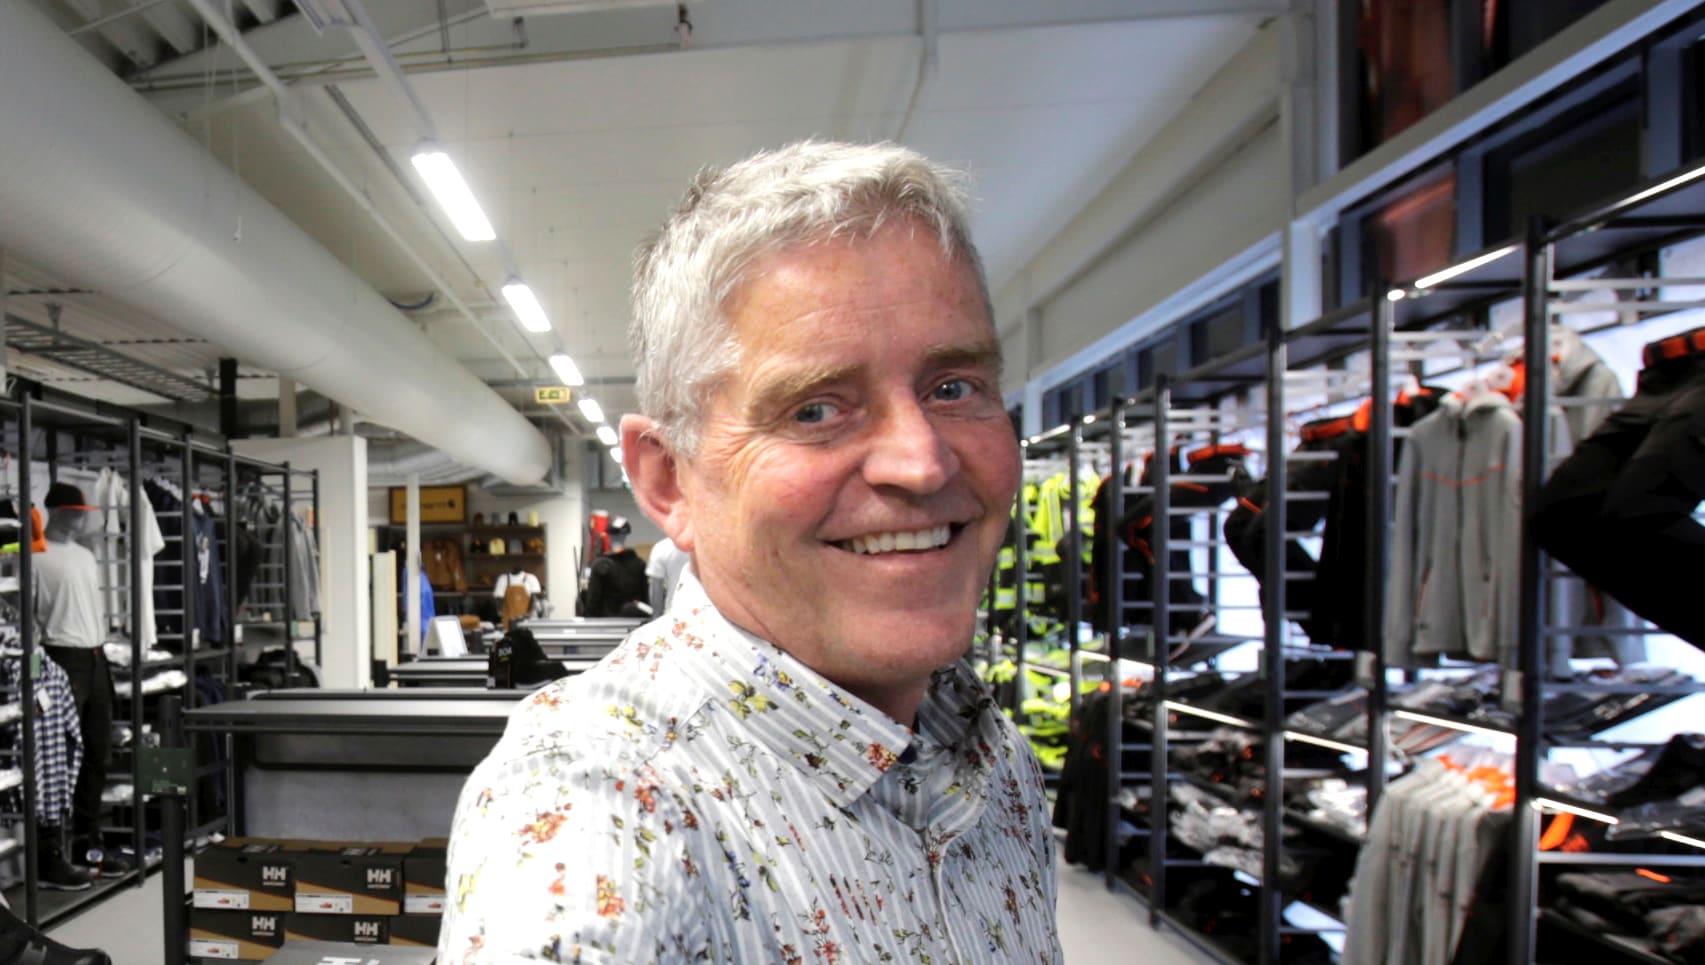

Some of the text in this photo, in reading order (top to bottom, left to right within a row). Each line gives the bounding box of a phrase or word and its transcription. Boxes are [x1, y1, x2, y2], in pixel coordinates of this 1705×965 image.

[262, 866, 286, 880] HH
[367, 869, 391, 883] HH
[252, 916, 275, 930] HH
[355, 921, 378, 936] HH
